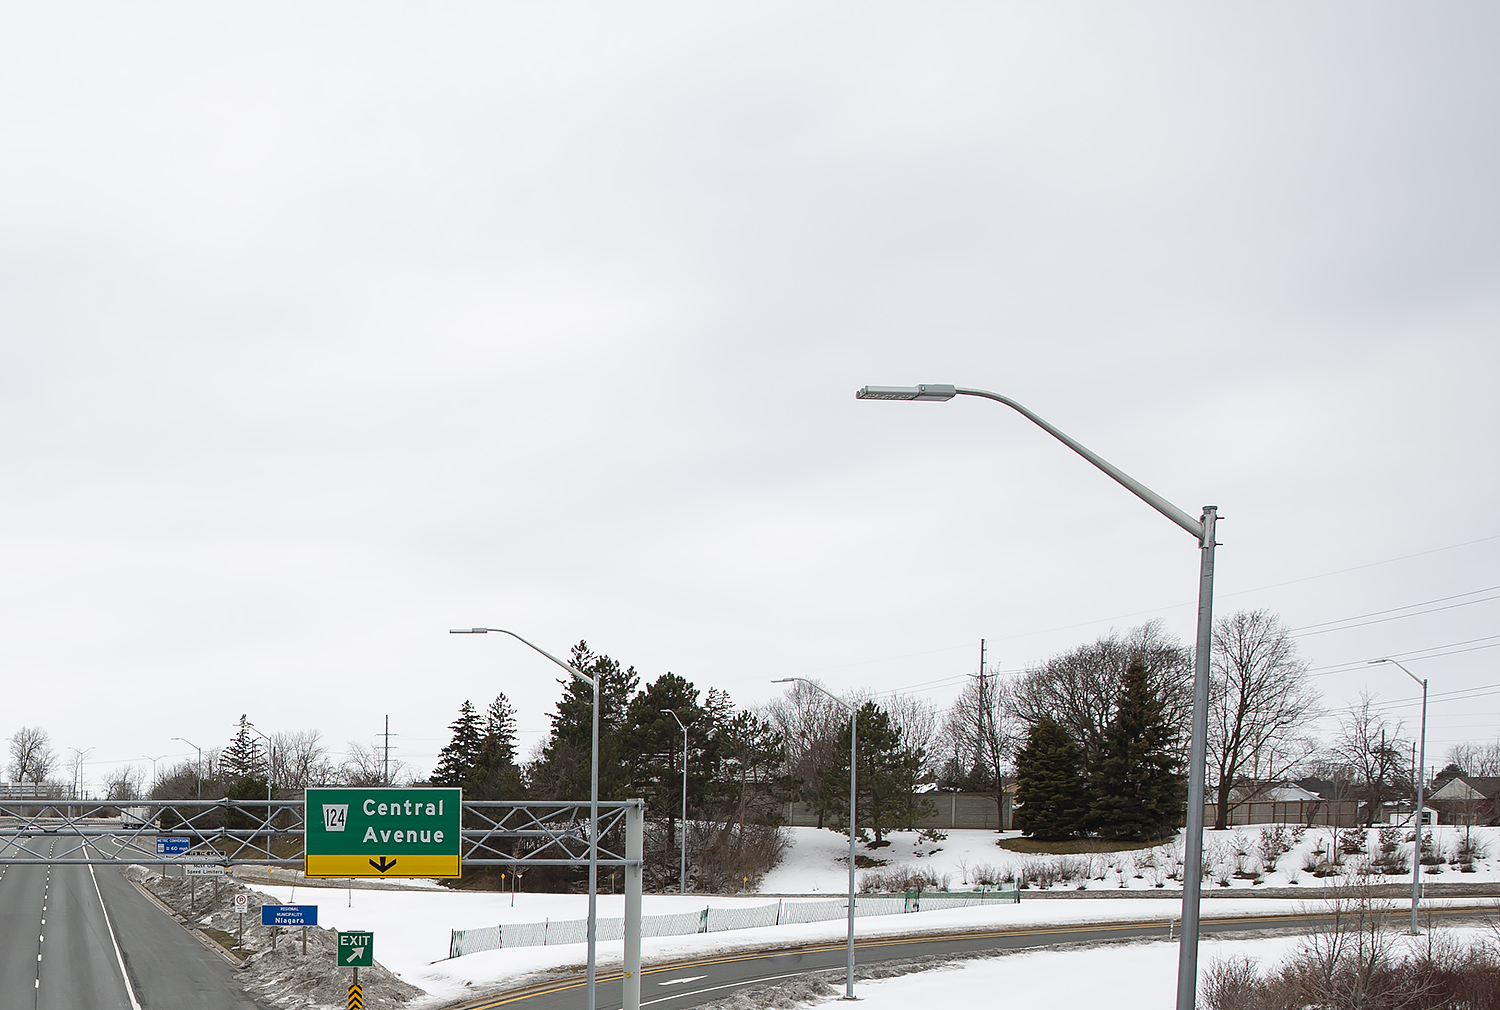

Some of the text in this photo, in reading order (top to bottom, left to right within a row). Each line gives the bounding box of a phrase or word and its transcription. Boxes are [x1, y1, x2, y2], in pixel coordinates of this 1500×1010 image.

[362, 798, 444, 816] Central
[325, 808, 345, 827] 124
[362, 826, 444, 843] Avenue
[275, 917, 305, 925] Niagara
[340, 935, 371, 946] EXIT
